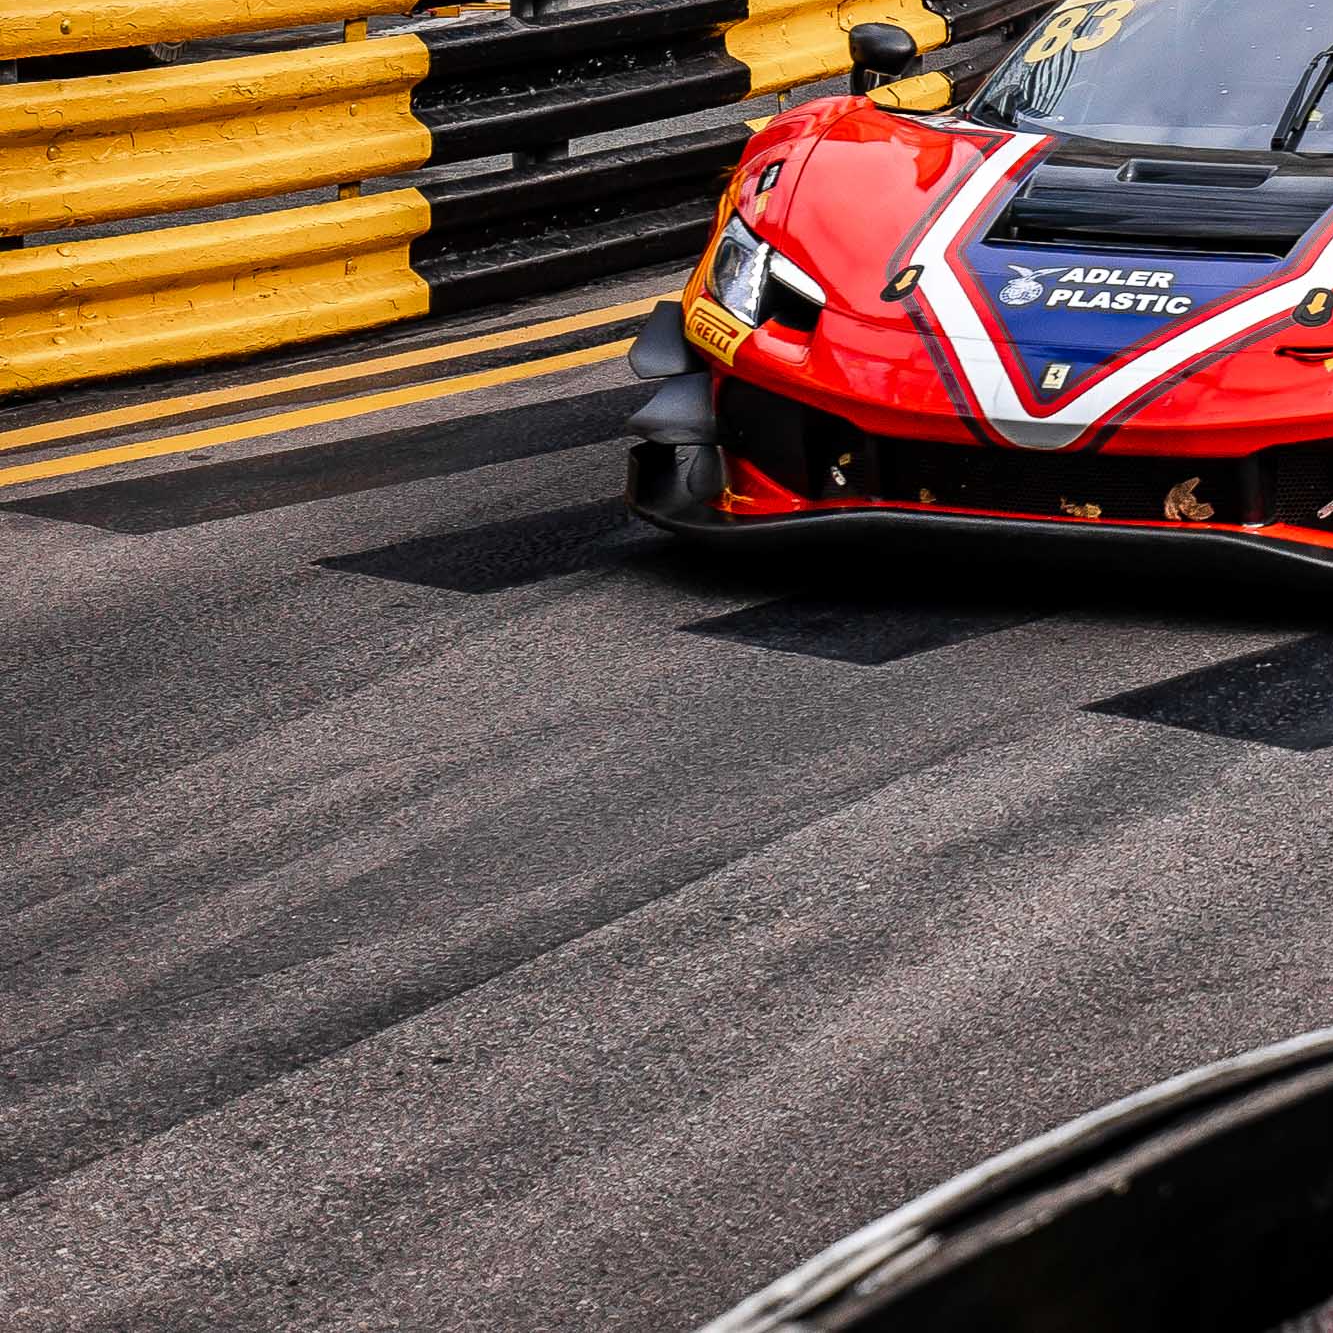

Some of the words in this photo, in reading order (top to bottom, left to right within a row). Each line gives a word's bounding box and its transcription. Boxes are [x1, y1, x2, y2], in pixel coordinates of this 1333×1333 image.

[1023, 0, 1135, 64] 83
[1059, 268, 1174, 288] ADLER
[1046, 290, 1192, 314] PLASTIC
